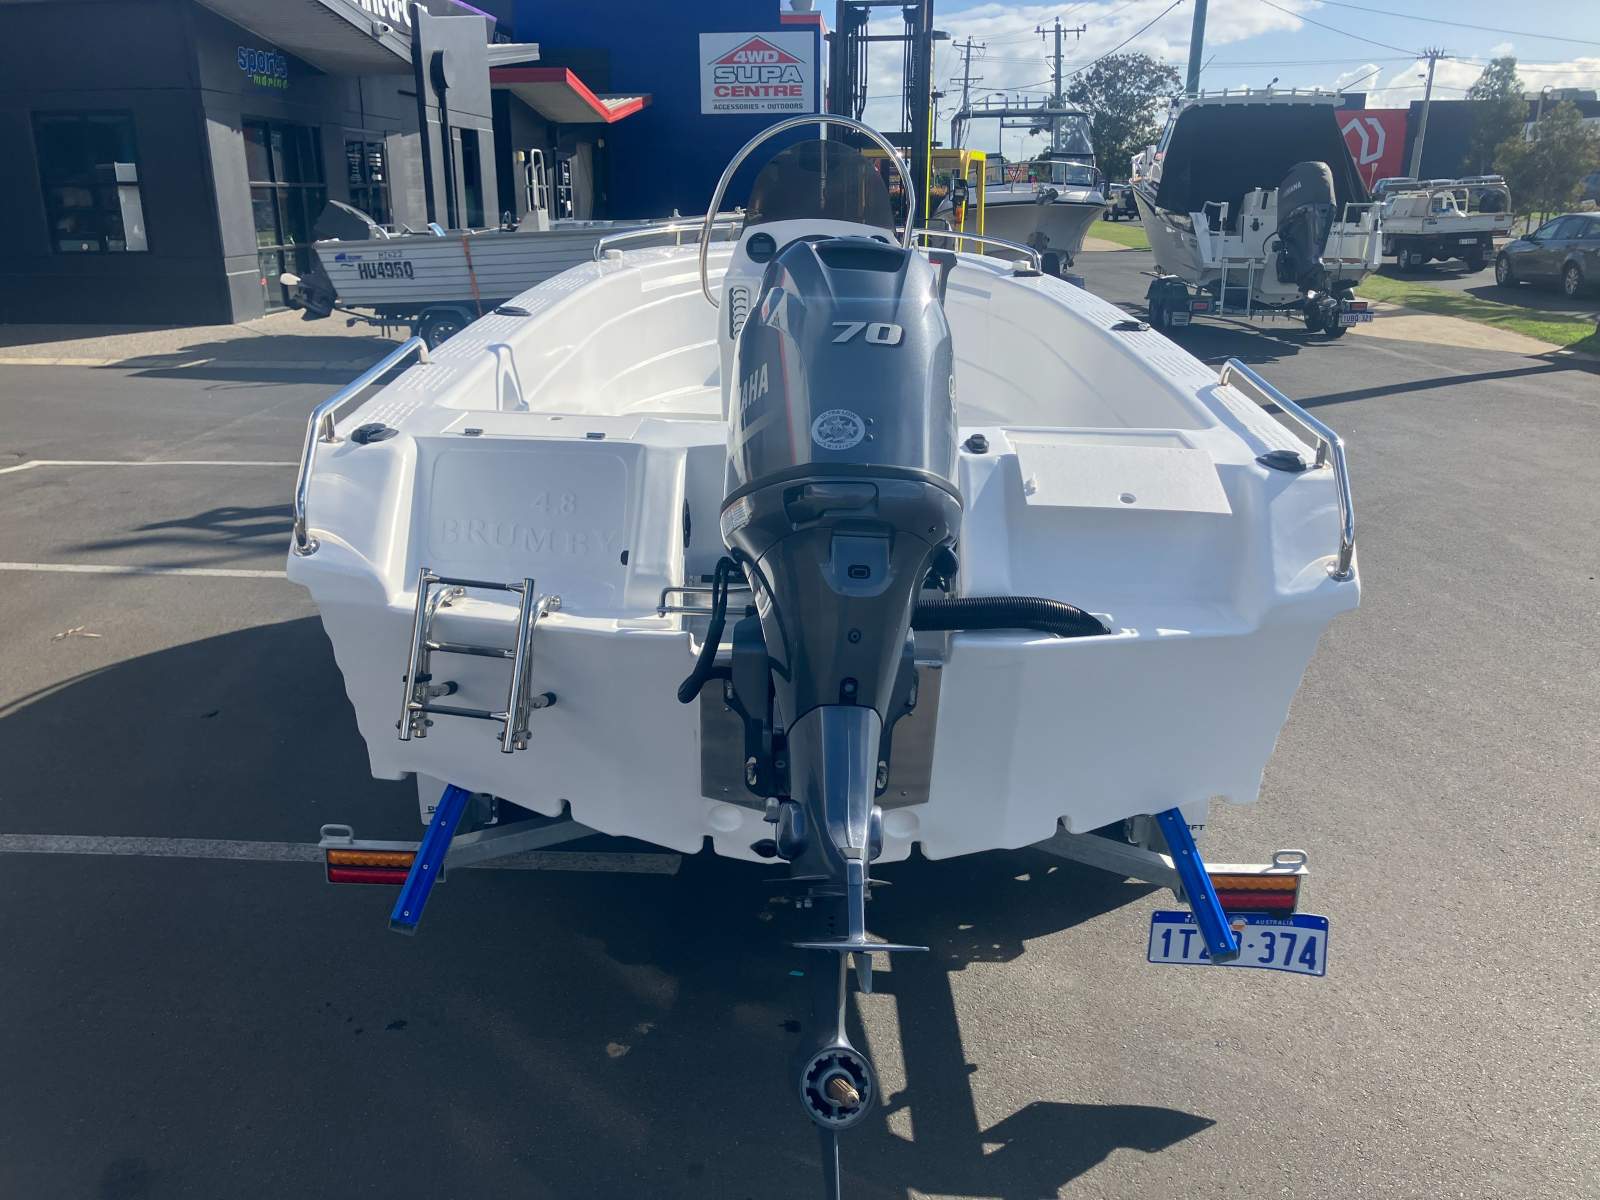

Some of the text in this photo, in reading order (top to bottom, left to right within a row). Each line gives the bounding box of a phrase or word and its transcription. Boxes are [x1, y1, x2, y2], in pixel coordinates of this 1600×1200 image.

[237, 46, 288, 78] sports
[733, 50, 779, 63] 4WD
[714, 65, 804, 84] SUPA
[714, 85, 803, 97] CENTRE
[713, 102, 804, 110] ACCESSORIES OUTDOORS
[832, 321, 903, 345] 70
[440, 519, 617, 554] BRUMBY
[1255, 918, 1294, 926] AUSTRALIA
